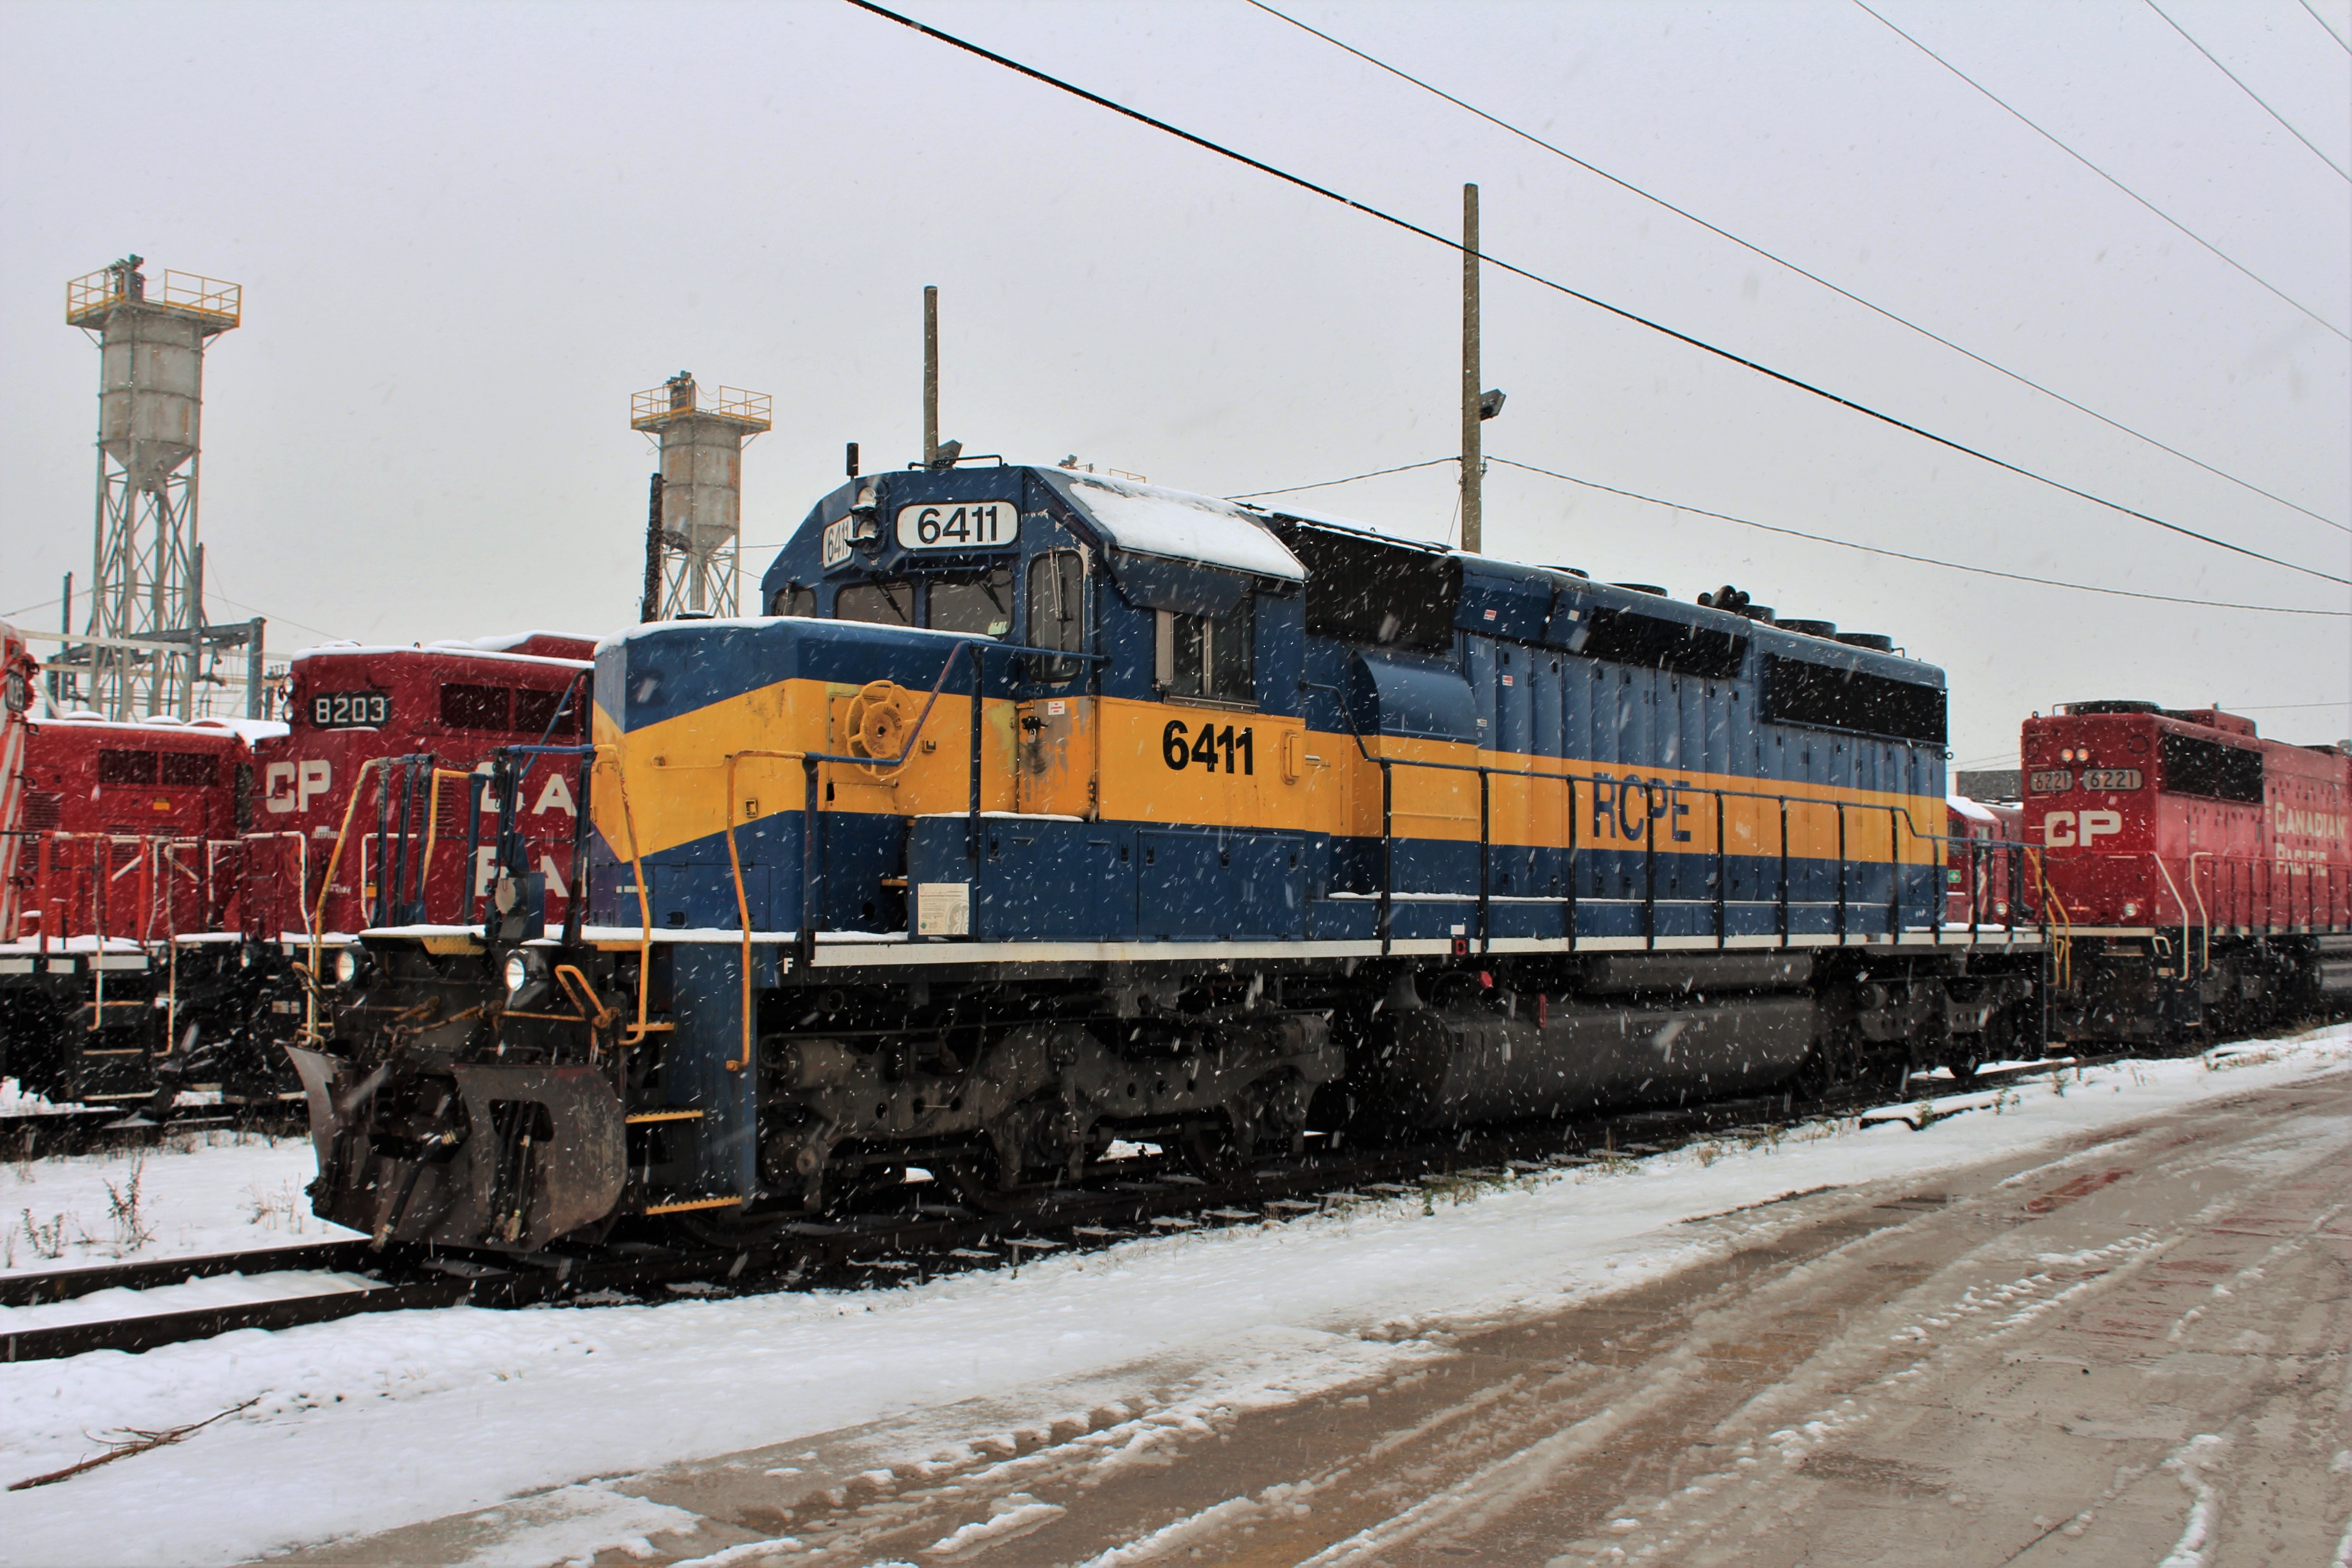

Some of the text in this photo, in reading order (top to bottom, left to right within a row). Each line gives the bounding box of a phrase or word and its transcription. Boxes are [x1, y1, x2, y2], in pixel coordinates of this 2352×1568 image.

[828, 520, 848, 563] 6411
[918, 505, 997, 544] 6411
[315, 696, 386, 723] 8203
[1162, 720, 1253, 775] 6411
[266, 760, 332, 813] CP
[2036, 772, 2068, 789] 6221
[2091, 772, 2133, 788] 6221
[1593, 772, 1691, 842] RCPE
[2275, 801, 2346, 839] CANADIAN
[2044, 810, 2122, 847] CP
[784, 957, 794, 974] F
